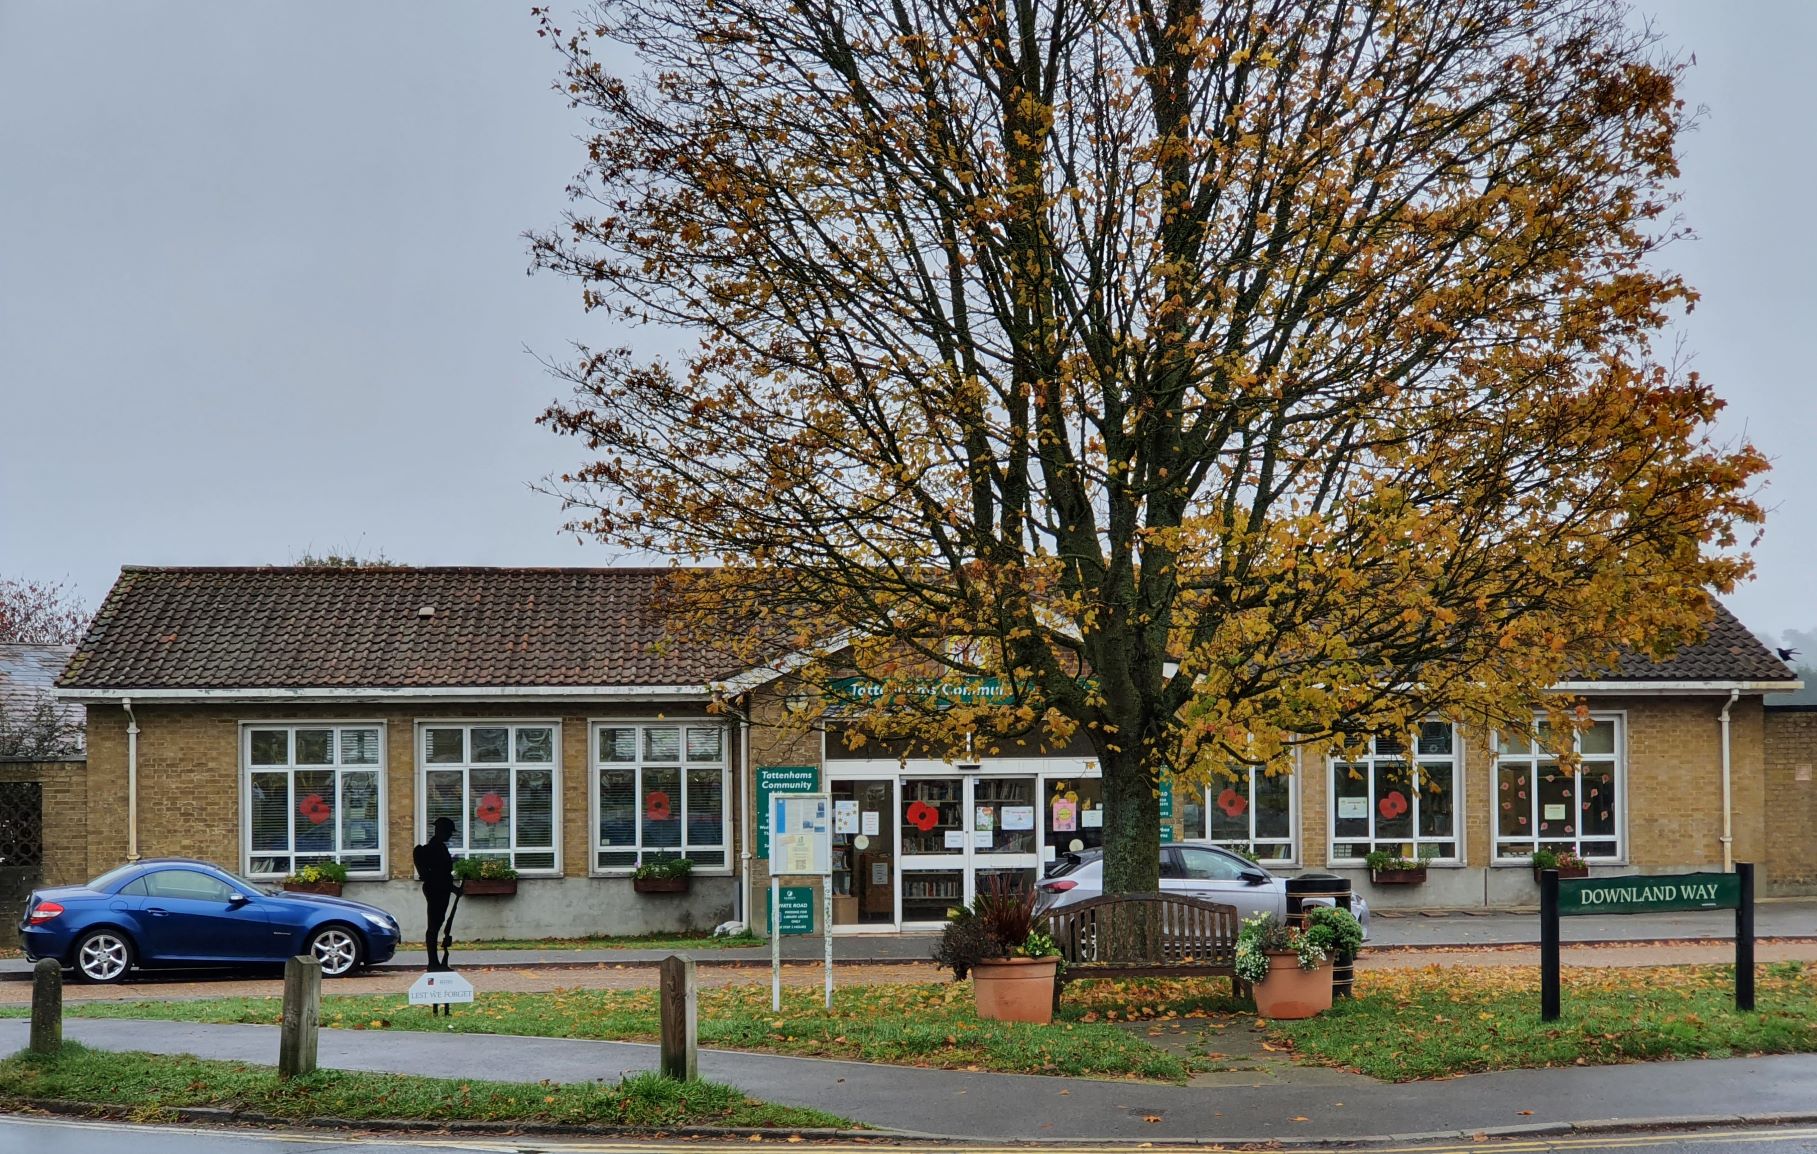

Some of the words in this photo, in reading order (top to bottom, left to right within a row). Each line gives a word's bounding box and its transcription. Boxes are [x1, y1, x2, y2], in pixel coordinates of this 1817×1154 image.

[761, 771, 812, 779] Tattenhams
[761, 781, 812, 790] Community
[1581, 885, 1677, 905] DOWNLAND
[1680, 884, 1718, 900] WAY
[443, 990, 473, 998] FORGET
